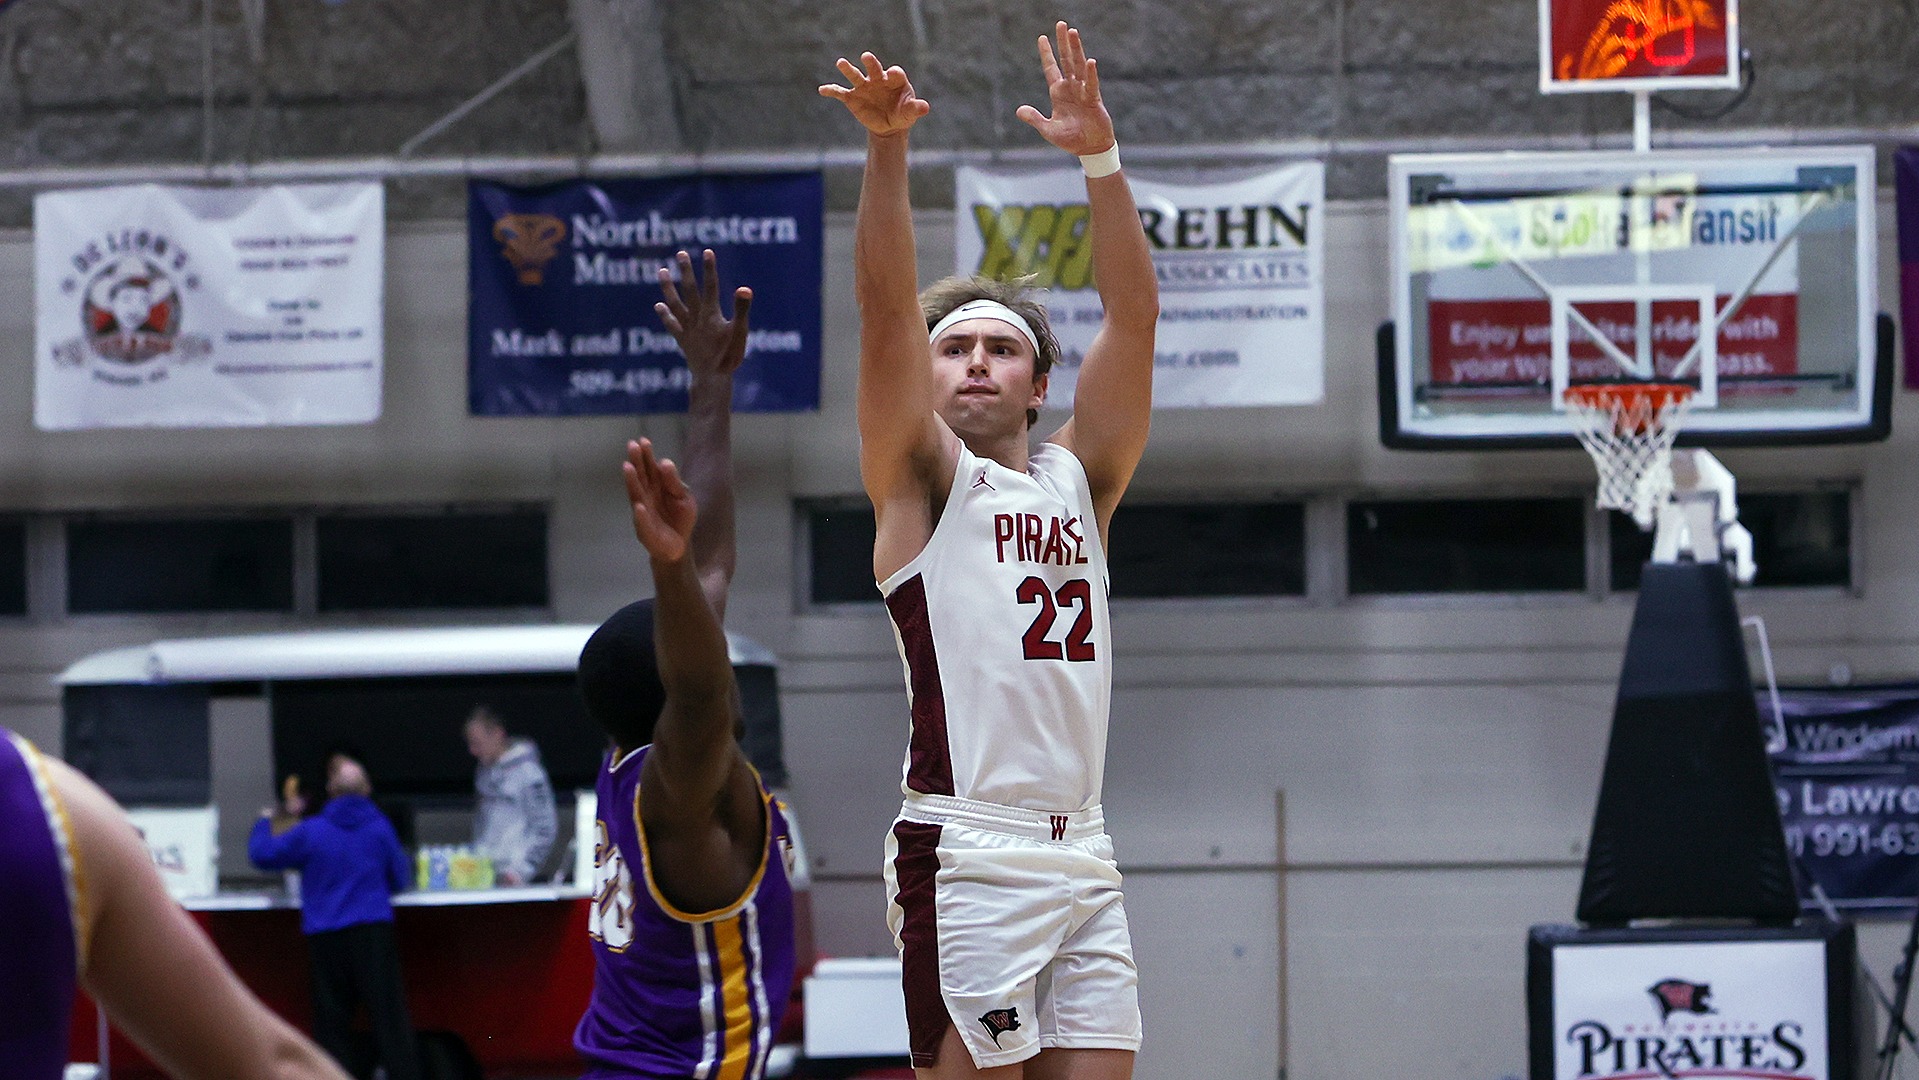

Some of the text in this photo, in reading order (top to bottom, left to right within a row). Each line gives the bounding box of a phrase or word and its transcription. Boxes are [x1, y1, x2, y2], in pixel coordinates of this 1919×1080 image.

[571, 210, 799, 248] Northwestern
[491, 328, 563, 356] Mark
[571, 328, 622, 356] and
[1450, 319, 1520, 352] Enjoy
[1723, 315, 1778, 340] with
[1015, 576, 1095, 662] 22
[1050, 815, 1068, 840] W
[988, 1014, 1010, 1029] W
[1567, 1020, 1807, 1079] PIRATES
